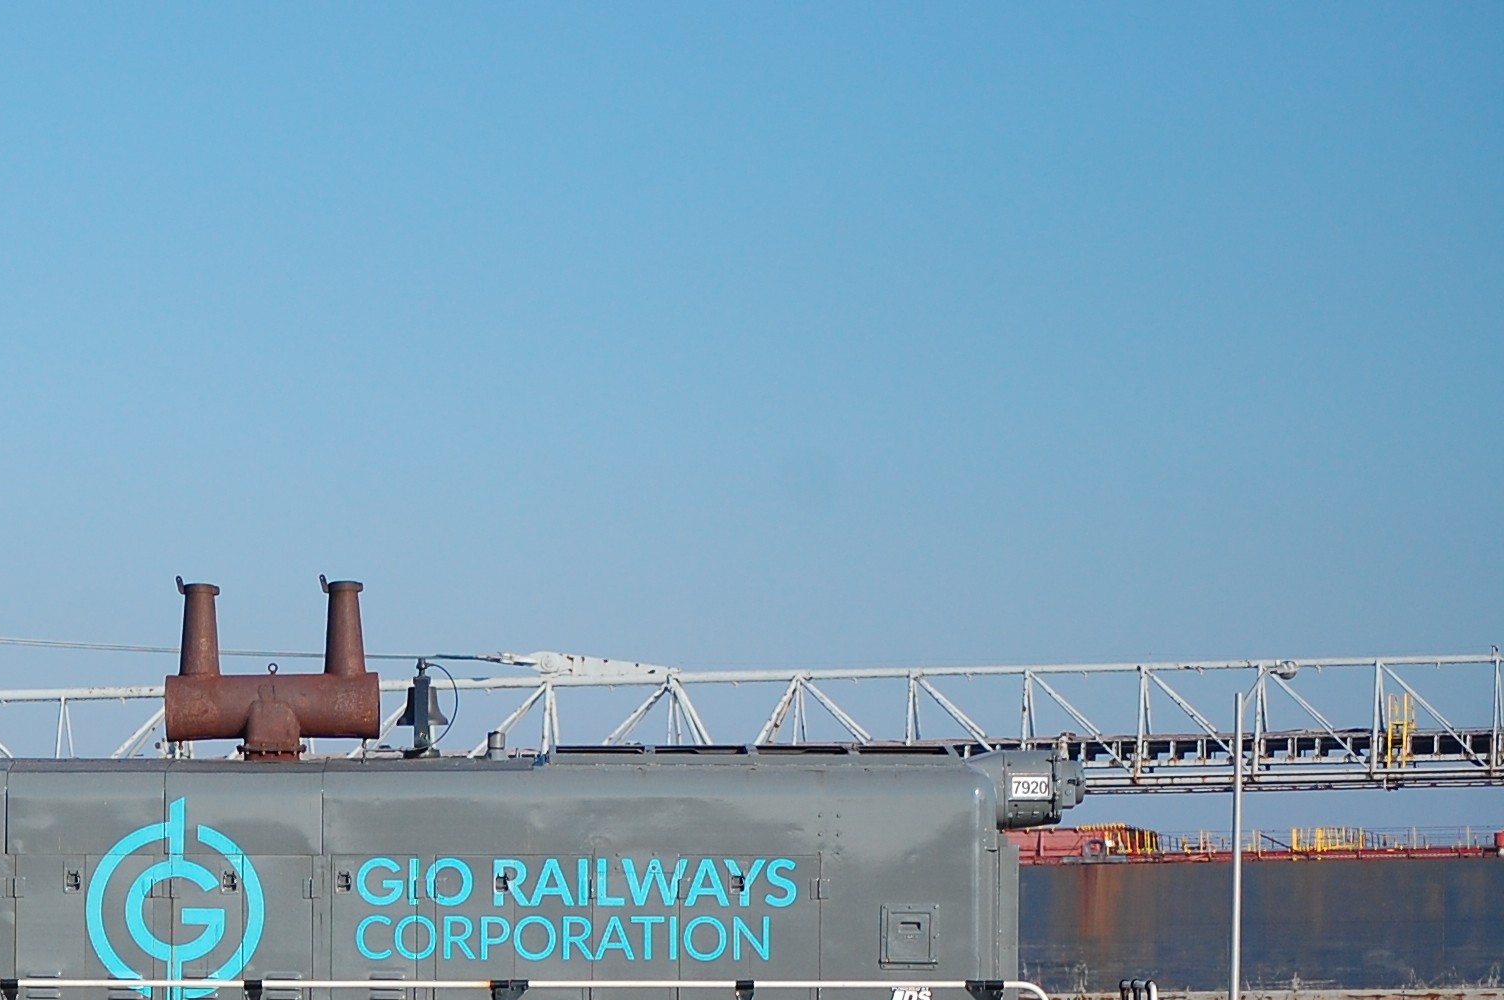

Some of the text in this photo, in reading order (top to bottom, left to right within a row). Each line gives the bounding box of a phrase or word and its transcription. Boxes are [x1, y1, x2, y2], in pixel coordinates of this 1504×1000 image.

[1012, 780, 1048, 795] 7920
[356, 857, 797, 907] GIO RAILWAYS
[355, 915, 770, 961] CORPORATION
